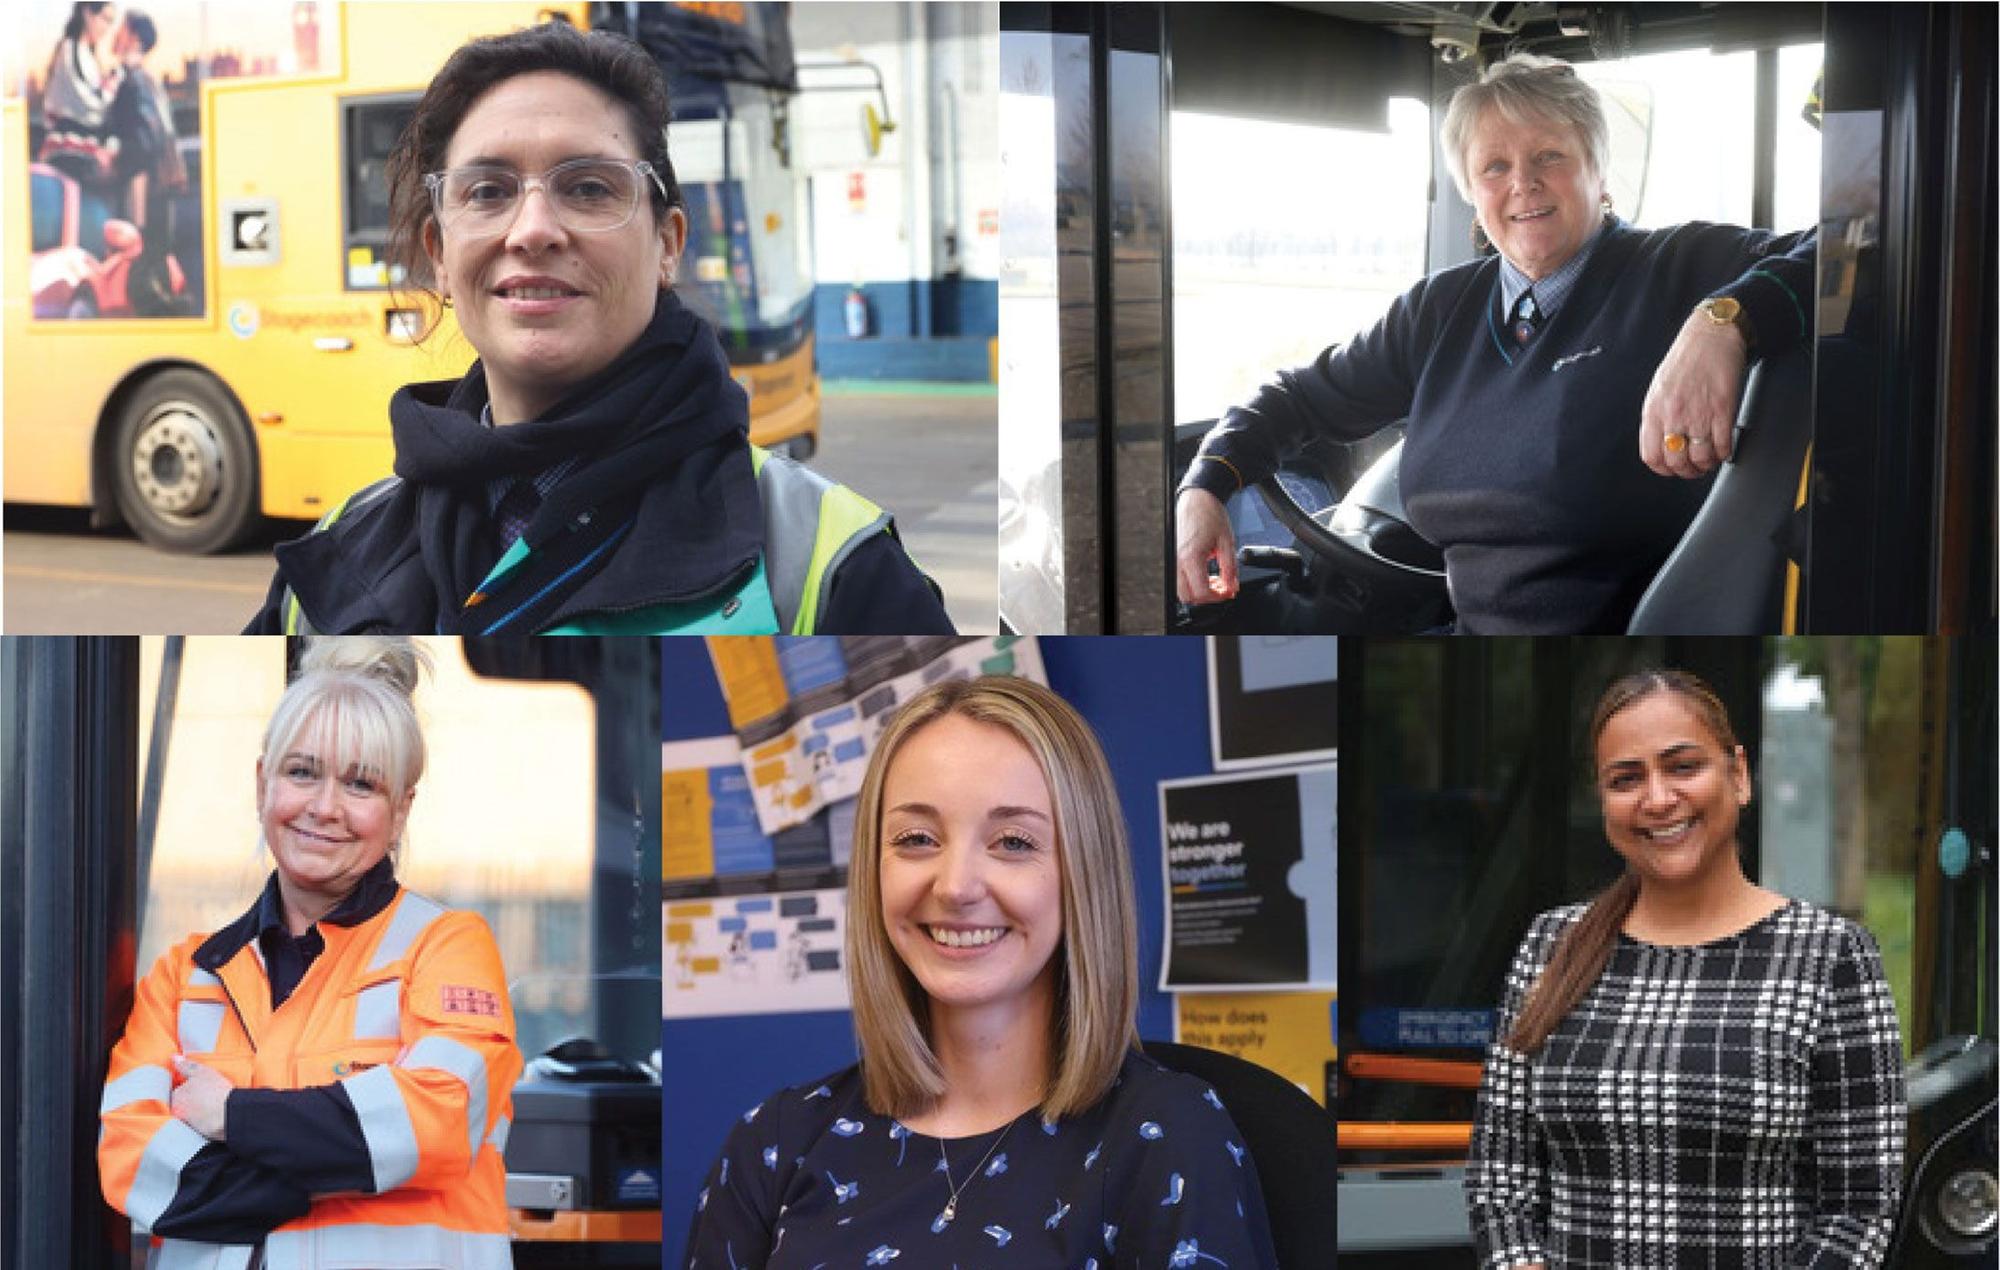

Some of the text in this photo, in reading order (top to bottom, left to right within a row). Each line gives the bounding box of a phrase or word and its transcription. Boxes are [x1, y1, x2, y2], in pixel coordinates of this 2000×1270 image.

[1167, 821, 1231, 841] We are
[1168, 841, 1245, 864] stronger
[1169, 863, 1248, 885] together
[1182, 1007, 1268, 1026] How does
[1218, 1028, 1266, 1051] apply
